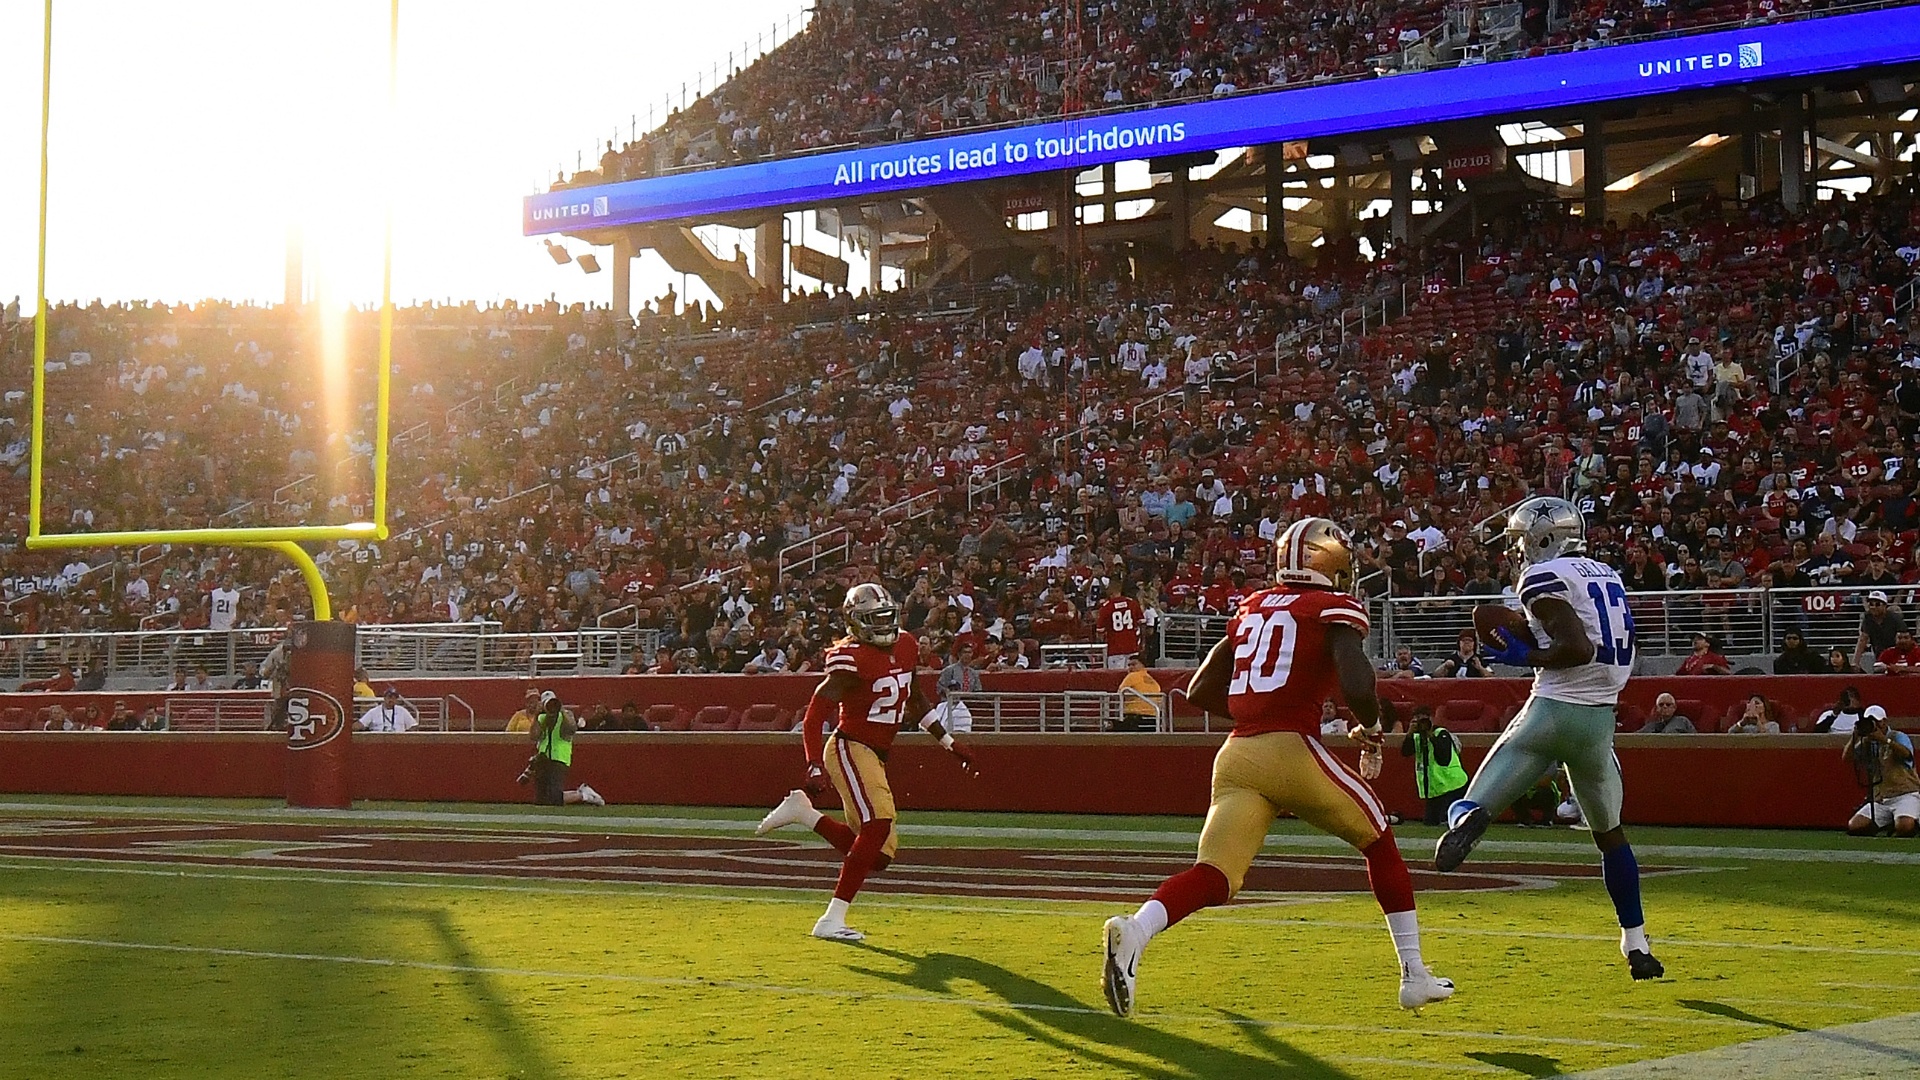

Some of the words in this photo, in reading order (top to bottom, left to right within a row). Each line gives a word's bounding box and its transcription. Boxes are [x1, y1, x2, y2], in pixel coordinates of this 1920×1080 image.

[1639, 52, 1733, 77] UNITED
[834, 163, 863, 187] All
[870, 155, 941, 181] routes
[949, 143, 997, 171] lead
[1004, 141, 1028, 163] to
[1036, 122, 1186, 159] touchdowns
[1470, 155, 1492, 168] 103
[533, 203, 591, 221] UNITED
[1627, 426, 1641, 441] 81
[216, 599, 231, 614] 21
[1804, 595, 1836, 612] 104
[1112, 609, 1133, 632] 84
[1587, 581, 1636, 667] 13
[254, 633, 271, 646] 102
[1228, 610, 1298, 696] 20
[867, 671, 913, 724] 27
[287, 697, 327, 741] SF
